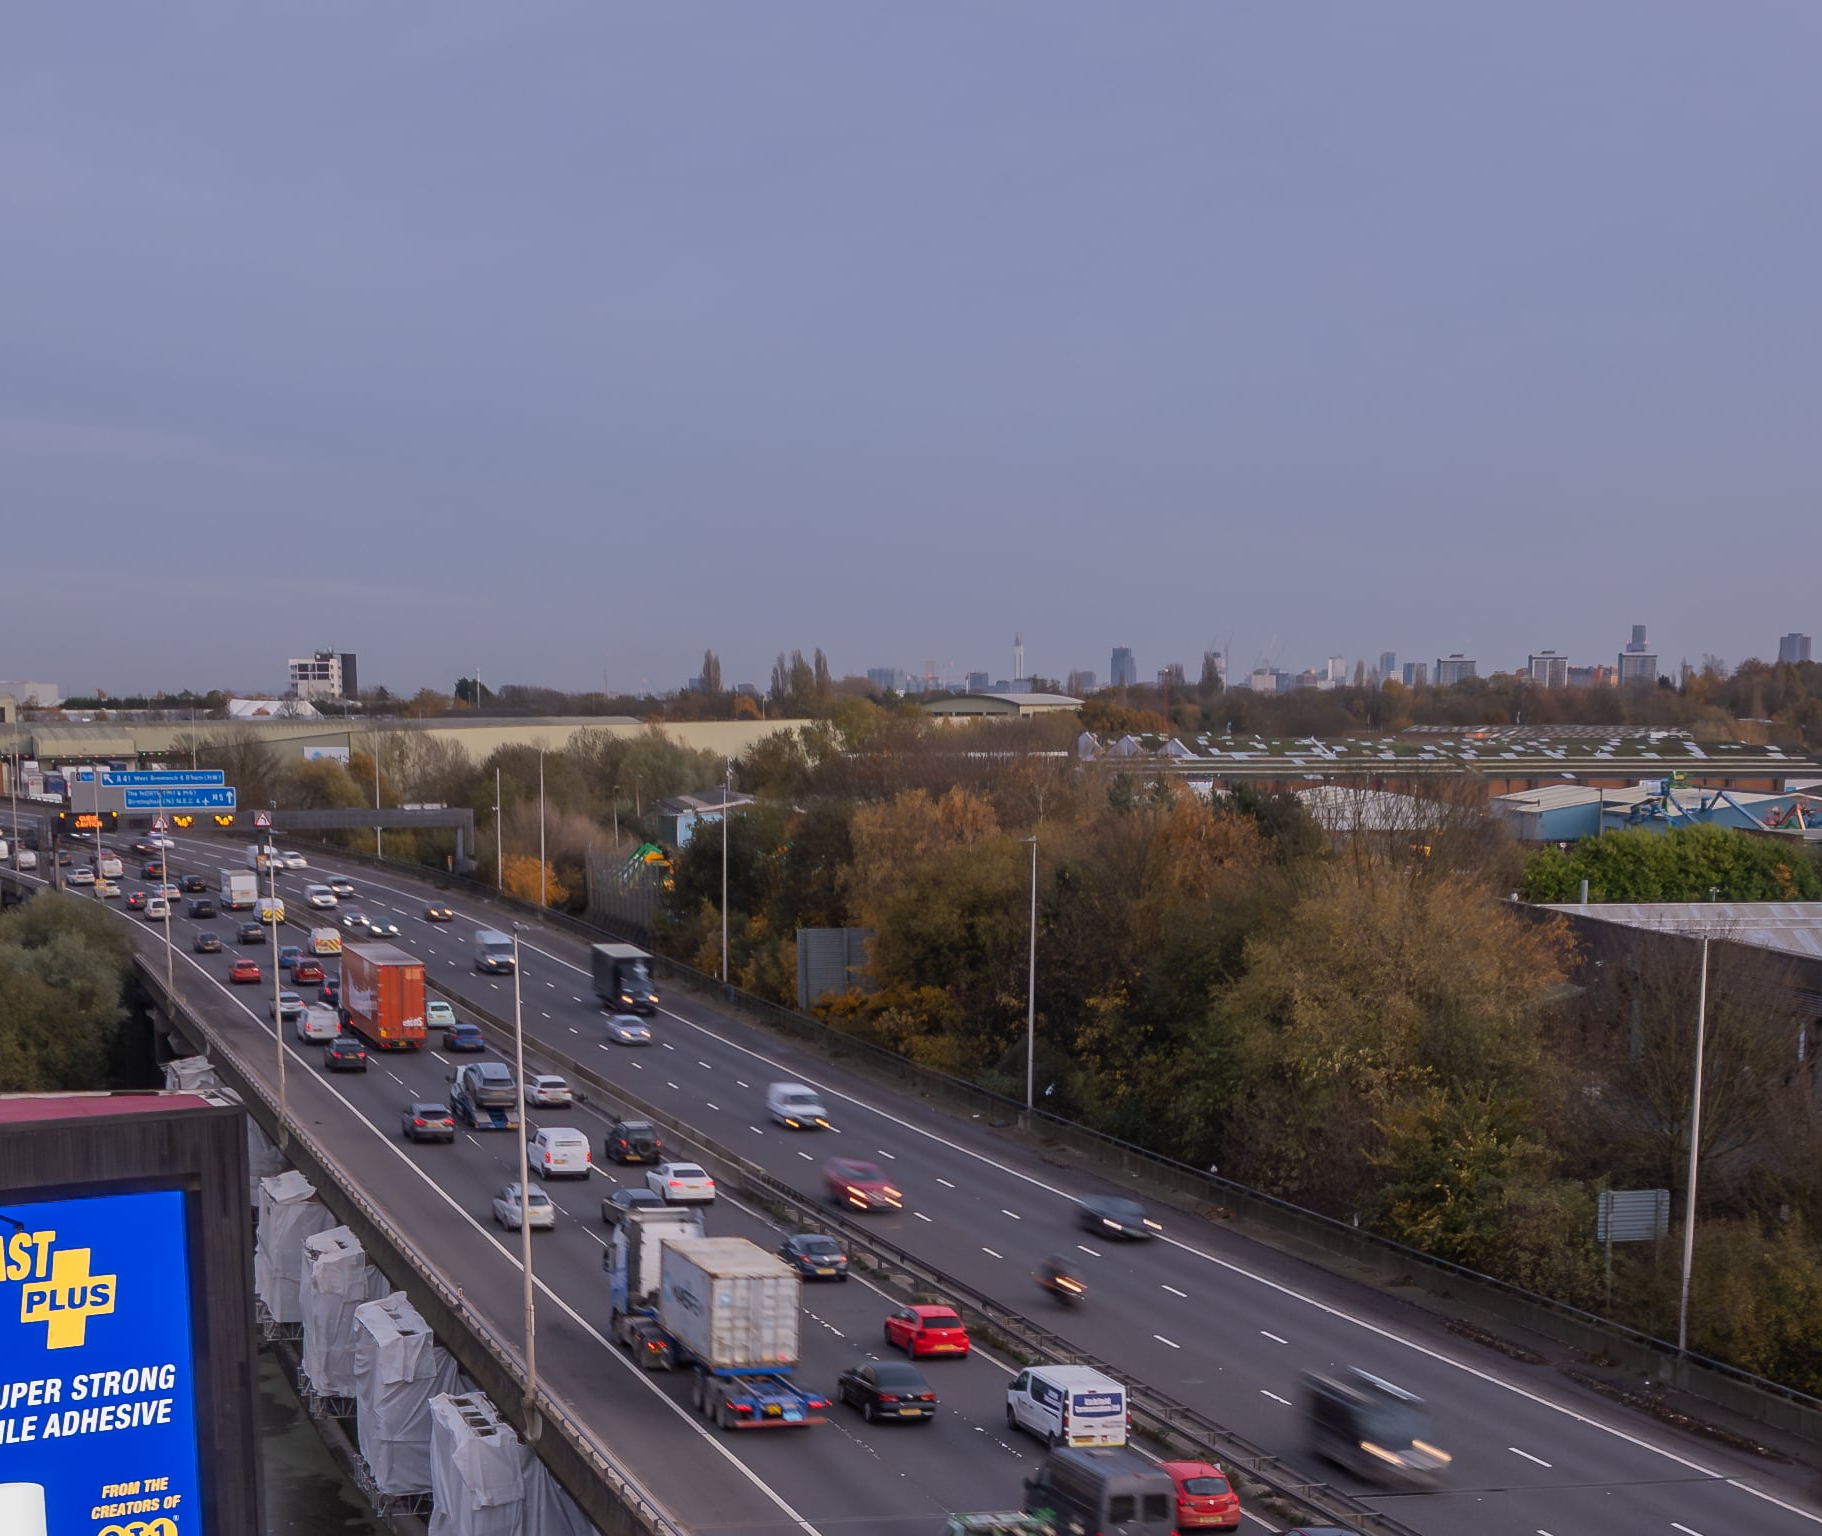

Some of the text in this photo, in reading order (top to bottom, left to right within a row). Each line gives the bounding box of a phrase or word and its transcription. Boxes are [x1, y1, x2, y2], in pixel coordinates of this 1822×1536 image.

[25, 1283, 111, 1314] PLUS
[71, 1364, 176, 1401] STRONG
[42, 1398, 173, 1439] ADHESIVE
[102, 1477, 169, 1498] FROM THE
[91, 1494, 181, 1519] CREATORS OF
